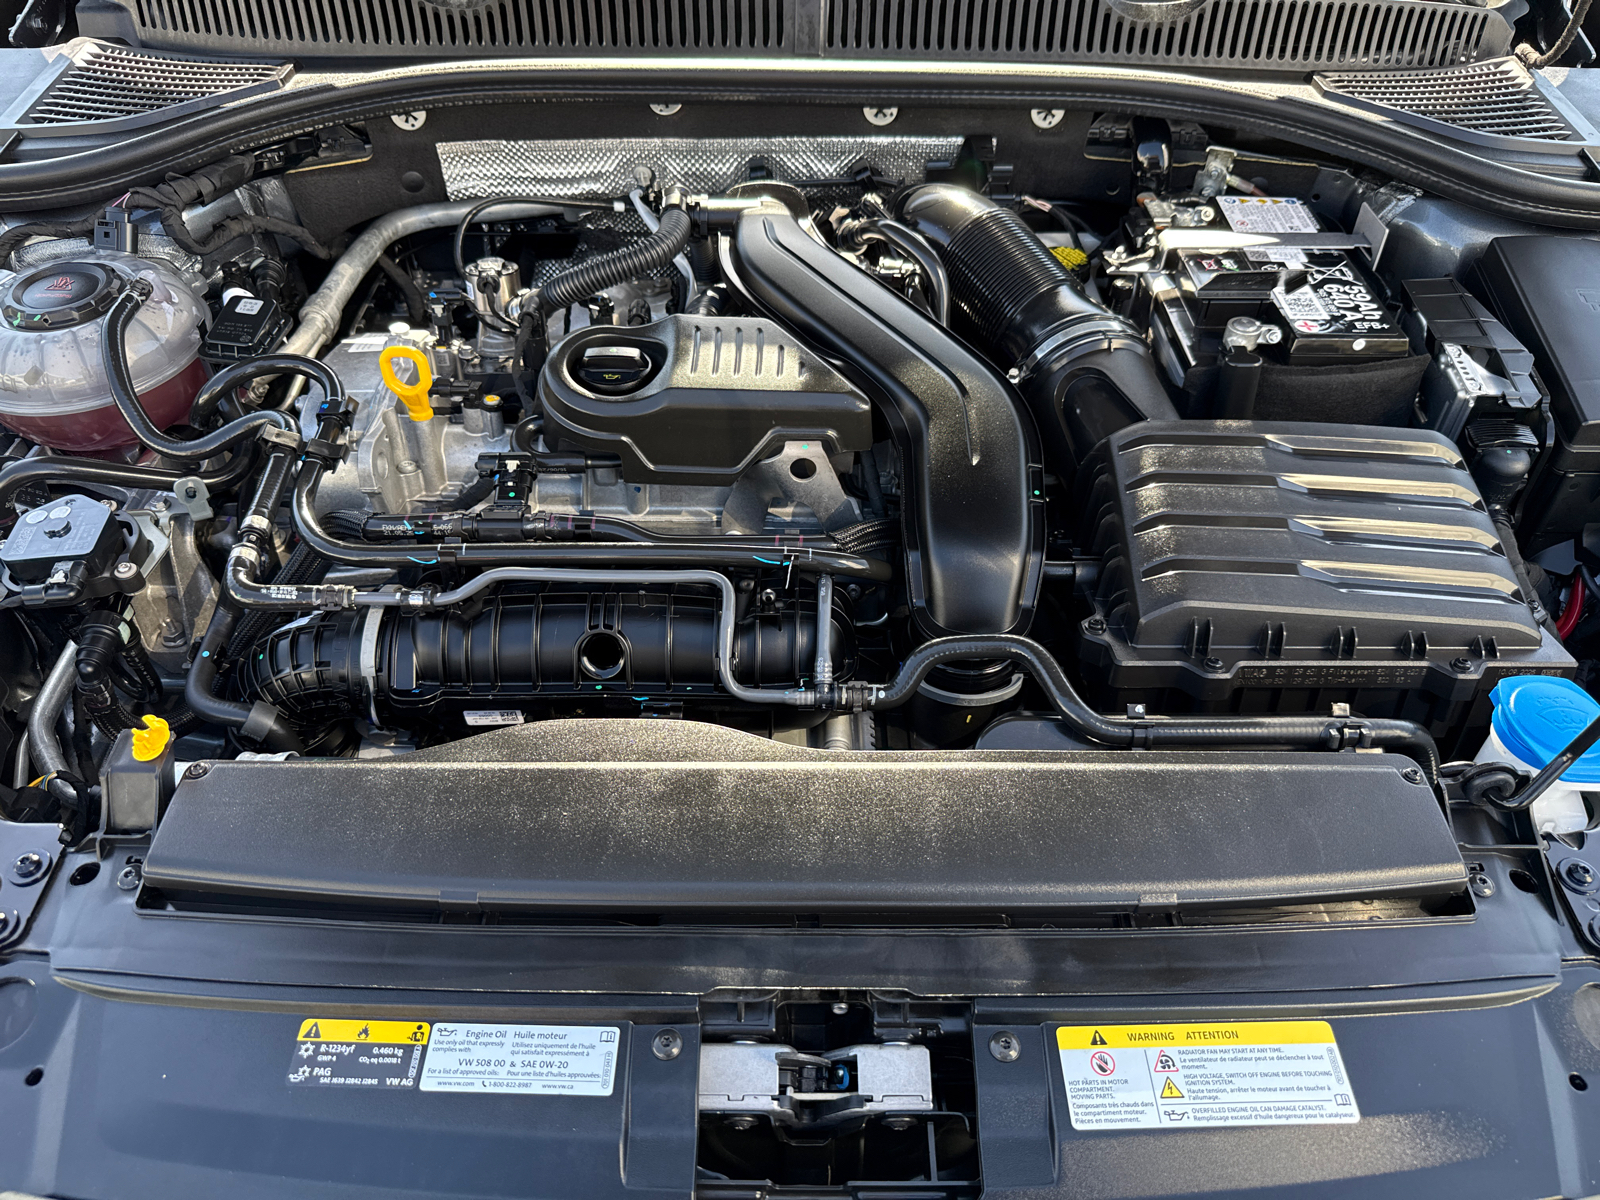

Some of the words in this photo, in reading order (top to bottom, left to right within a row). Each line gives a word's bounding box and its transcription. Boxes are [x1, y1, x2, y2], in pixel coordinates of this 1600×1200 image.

[1323, 284, 1354, 308] 640
[1340, 310, 1364, 320] A
[1344, 286, 1383, 320] 59Ah
[1354, 322, 1390, 330] EFB+
[466, 1030, 493, 1039] Engine
[514, 1031, 535, 1039] Huile
[1127, 1032, 1174, 1041] WARNING
[1186, 1031, 1239, 1040] ATTENTION
[320, 1044, 356, 1055] R-1234yf
[394, 1047, 404, 1056] kg
[520, 1060, 538, 1068] SAE
[539, 1061, 568, 1069] 0W-20
[313, 1067, 332, 1076] PAG
